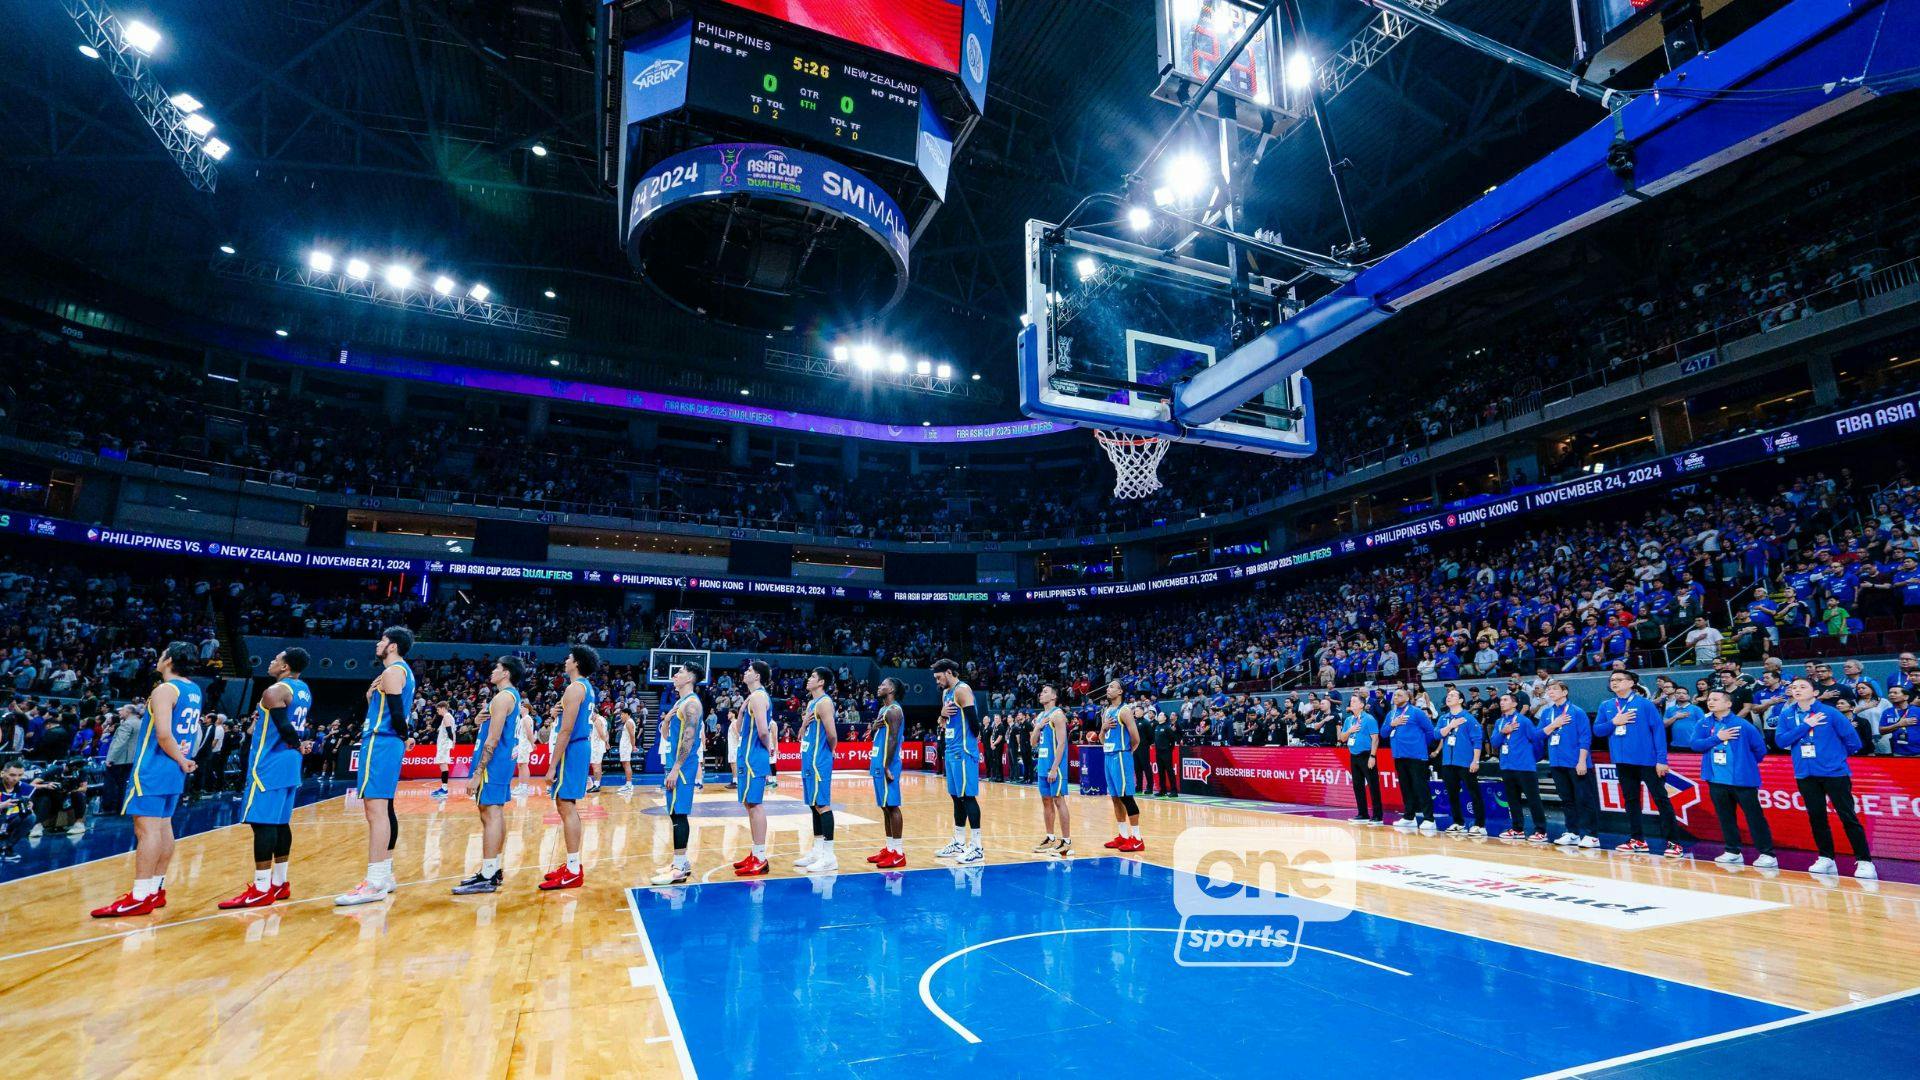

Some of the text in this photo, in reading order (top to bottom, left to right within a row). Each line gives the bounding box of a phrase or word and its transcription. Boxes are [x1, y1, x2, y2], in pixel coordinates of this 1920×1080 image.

[698, 22, 772, 51] PHILIPPINES
[713, 42, 732, 53] PTS
[736, 49, 749, 58] PF
[793, 56, 830, 79] 5:26
[639, 67, 676, 90] ARENA
[763, 73, 778, 92] 0
[843, 64, 918, 94] NEW ZEALAND
[750, 94, 785, 111] TF TOL
[799, 88, 819, 99] QTR
[871, 88, 919, 108] NO PTS PF
[772, 109, 779, 119] 2
[840, 96, 854, 114] 0
[829, 116, 861, 131] TOL TF
[835, 127, 841, 136] 2
[747, 159, 776, 174] ASIA
[778, 162, 803, 178] CUP
[650, 161, 699, 199] 2024
[747, 177, 802, 193] QUALIFIERS
[822, 170, 906, 252] SM MALL
[1684, 352, 1711, 373] 417
[1836, 402, 1917, 436] FIBA ASIA
[984, 427, 996, 437] CUP
[1374, 464, 1663, 545] PHILIPPINES VS. HONG KONG NOVEMBER 24, 2024
[101, 531, 411, 571] PHILIPPINES VS. NEW ZEALAND NOVEMBER 21, 2024
[1268, 560, 1279, 572] CUP
[1278, 557, 1293, 570] 2025
[1292, 547, 1332, 566] QUALIFIERS
[449, 563, 466, 574] FIBA
[467, 564, 484, 575] ASIA
[486, 565, 501, 576] CUP
[501, 567, 521, 577] 2025
[522, 567, 573, 581] QUALIFIERS
[622, 574, 673, 587] PHILIPPINES
[699, 579, 721, 589] HONG
[722, 580, 744, 591] KONG
[754, 583, 796, 594] NOVEMBER
[808, 585, 826, 595] 2024
[1033, 588, 1077, 600] PHILIPPINES
[1097, 585, 1114, 595] NEW
[1115, 582, 1147, 594] ZEALAND
[1152, 576, 1189, 589] NOVEMBER
[1200, 572, 1218, 583] 2024
[921, 592, 933, 601] CUP
[933, 592, 948, 601] 2025
[176, 707, 201, 735] 33
[1184, 767, 1201, 779] LIVE
[1215, 768, 1255, 778] SUBSCRIBE
[1257, 769, 1272, 779] FOR
[1273, 770, 1295, 780] ONLY
[1405, 881, 1501, 898] BEER
